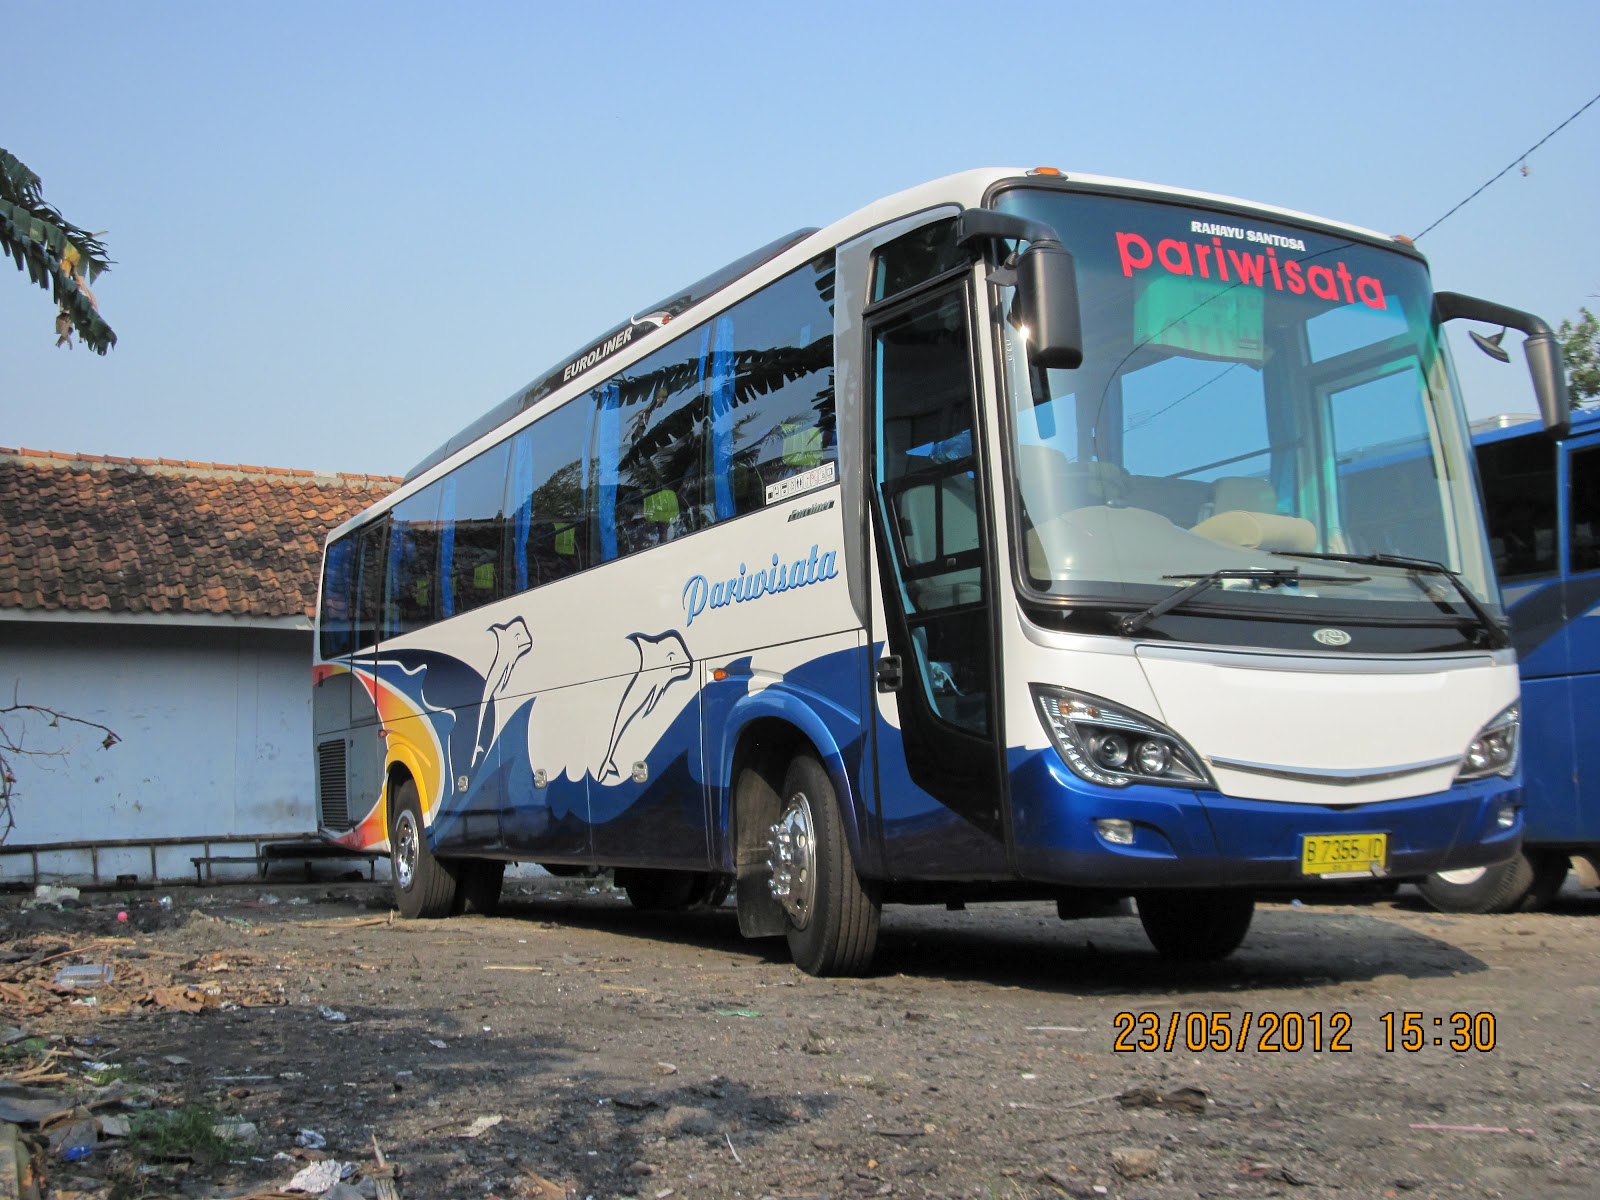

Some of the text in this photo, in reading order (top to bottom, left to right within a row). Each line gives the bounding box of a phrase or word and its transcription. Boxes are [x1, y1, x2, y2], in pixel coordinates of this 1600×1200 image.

[1191, 220, 1306, 252] RAHAYU SANTOSA
[1115, 231, 1387, 311] pariwisata
[563, 326, 633, 382] EUROLINER
[682, 543, 839, 627] Pariwisata
[1307, 841, 1317, 862] B
[1322, 839, 1360, 864] 7355
